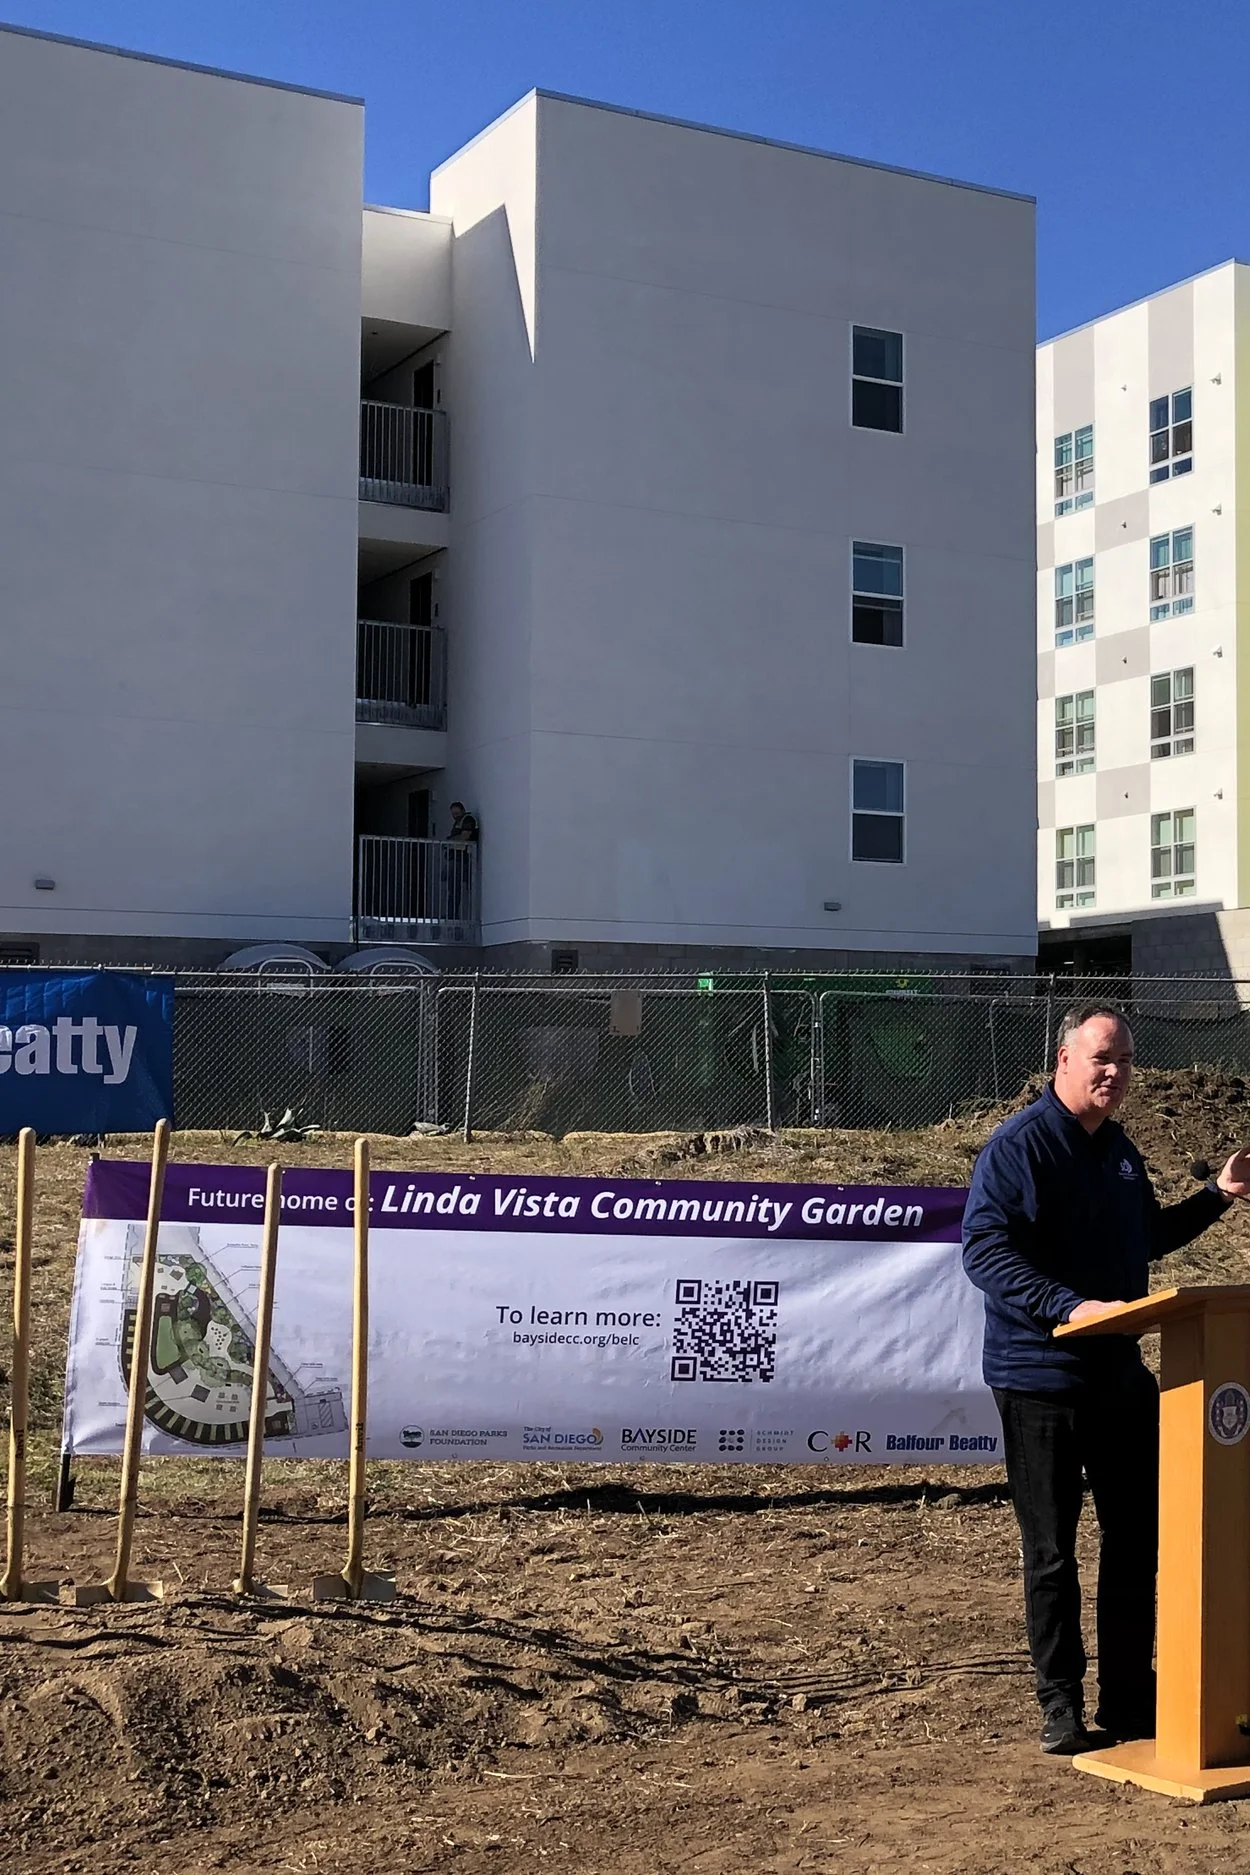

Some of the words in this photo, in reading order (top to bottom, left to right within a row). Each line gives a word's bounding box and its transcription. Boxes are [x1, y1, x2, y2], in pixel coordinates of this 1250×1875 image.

[188, 1187, 264, 1208] Future
[345, 1193, 374, 1212] o:
[381, 1184, 481, 1214] Linda
[493, 1187, 580, 1218] Vista
[591, 1191, 793, 1231] Community
[801, 1197, 924, 1227] Garden
[496, 1306, 523, 1324] To
[530, 1306, 588, 1325] learn
[595, 1311, 661, 1327] more:
[513, 1331, 640, 1347] baysidecc.org/belc
[429, 1429, 449, 1437] SAN
[523, 1432, 551, 1443] SAN
[554, 1433, 597, 1444] DIEGO
[621, 1428, 697, 1444] BAYSIDE
[429, 1438, 488, 1446] FOUNDATION
[621, 1444, 668, 1453] Community
[886, 1434, 945, 1451] Balfour
[949, 1434, 998, 1452] Beatty
